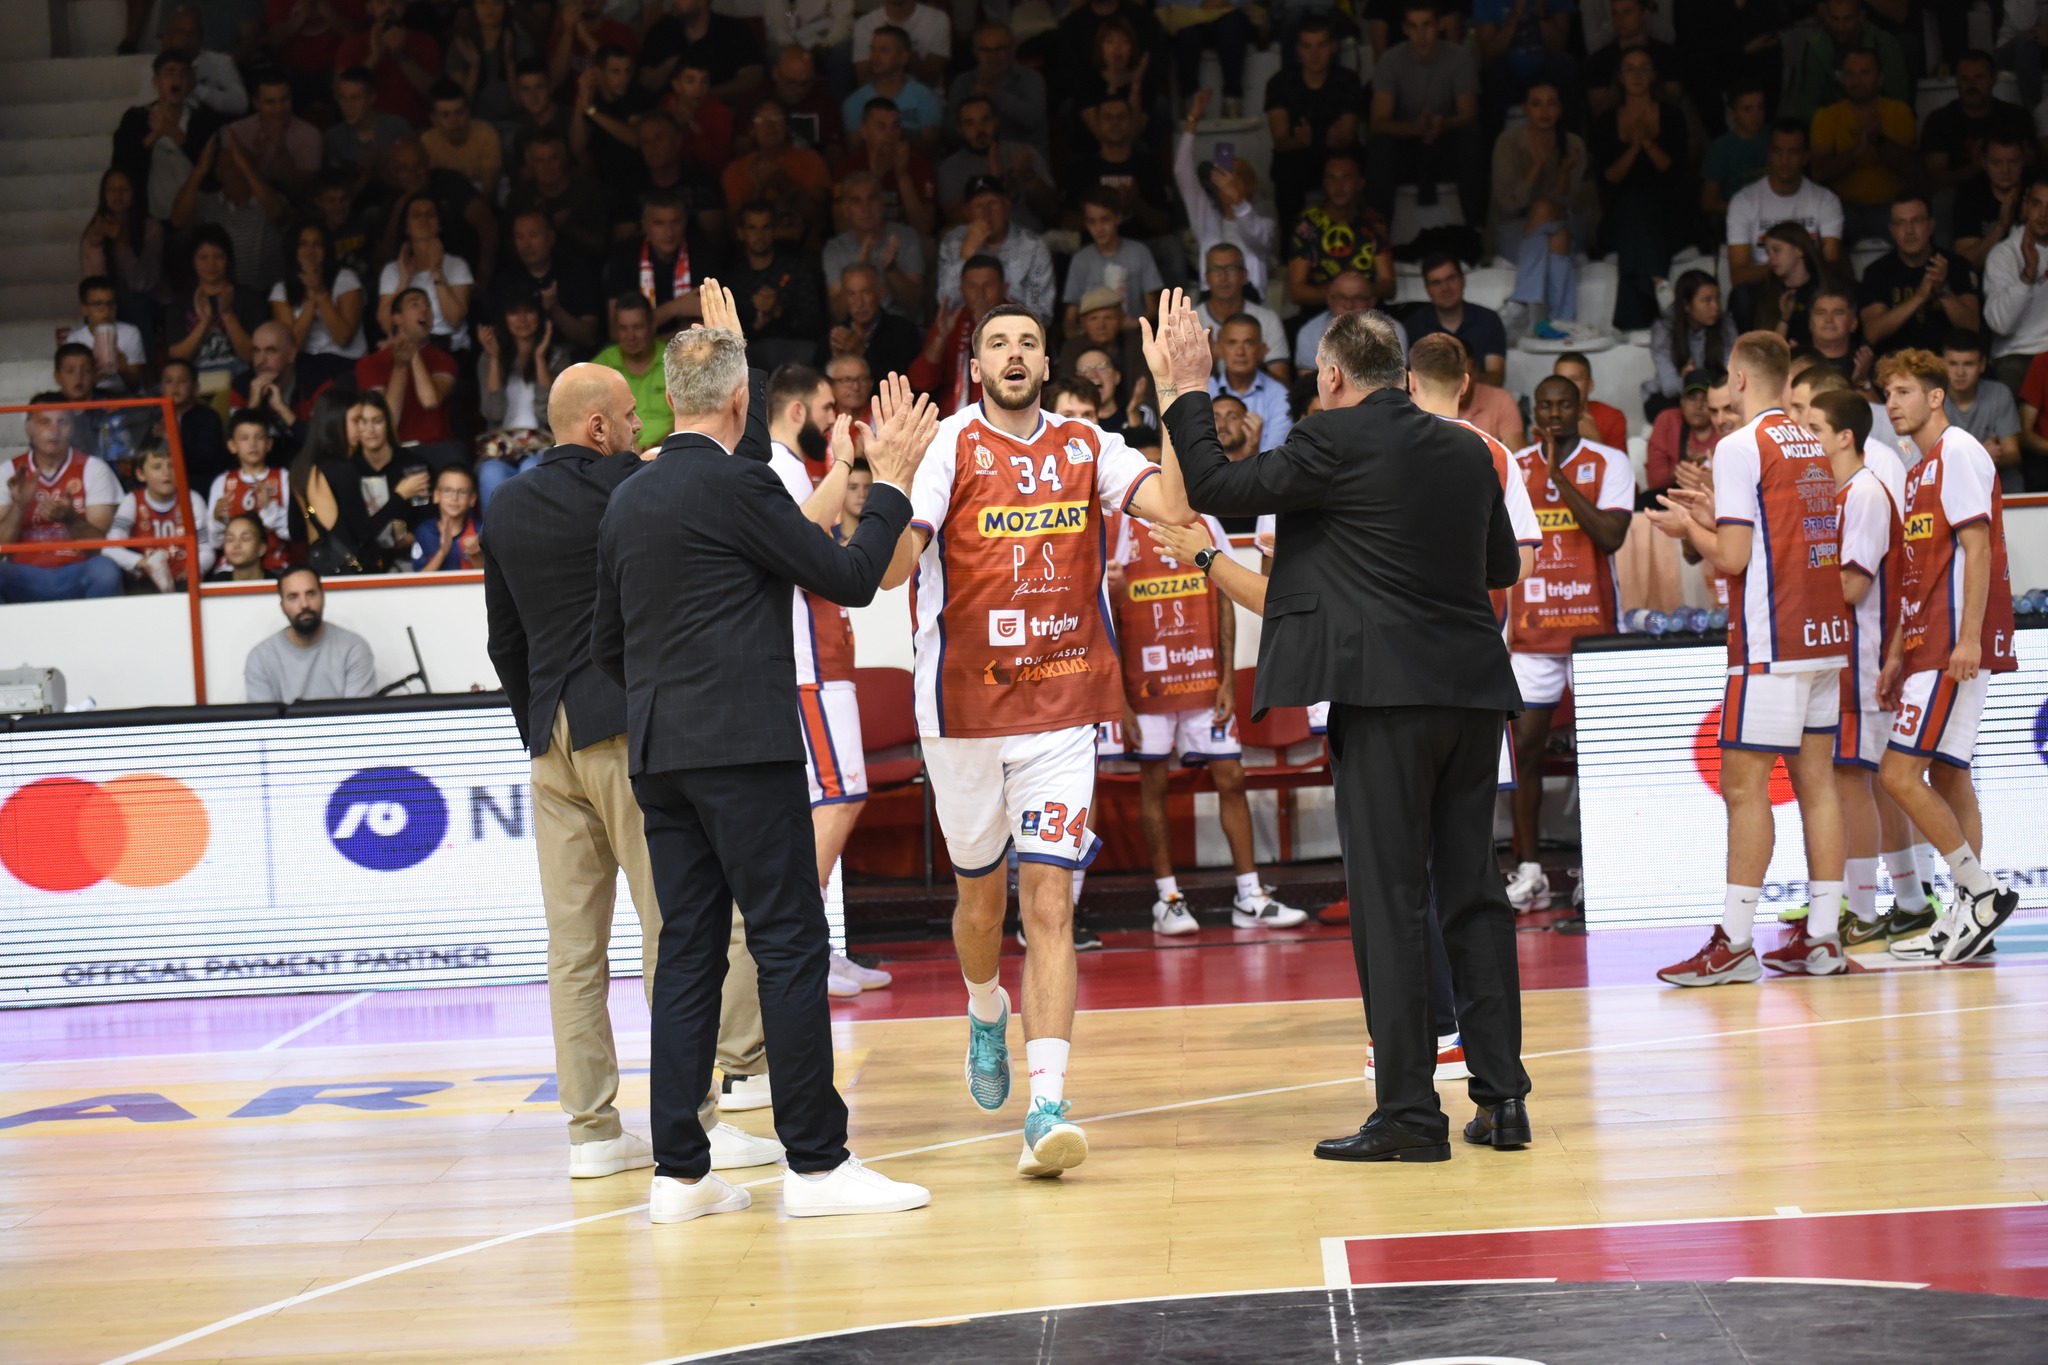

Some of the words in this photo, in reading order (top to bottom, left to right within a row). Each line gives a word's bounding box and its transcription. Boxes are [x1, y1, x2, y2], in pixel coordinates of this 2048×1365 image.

[1780, 442, 1828, 460] MOZZAR
[1009, 453, 1063, 495] 34
[241, 490, 255, 511] 6
[152, 519, 176, 537] 10
[984, 505, 1089, 533] MOZZART
[1013, 544, 1026, 582] P
[1042, 541, 1056, 581] S
[1010, 582, 1071, 602] fashion
[1134, 576, 1208, 599] MOZZART
[1547, 580, 1591, 600] triglav
[1030, 612, 1079, 641] triglav
[1052, 646, 1089, 659] FASAD
[1168, 644, 1214, 667] triglav
[1016, 656, 1092, 682] MAXIMA
[1039, 801, 1088, 848] 34
[62, 963, 196, 986] OFFICIAL
[205, 954, 342, 977] PAYMENT
[353, 945, 494, 971] PARTNER
